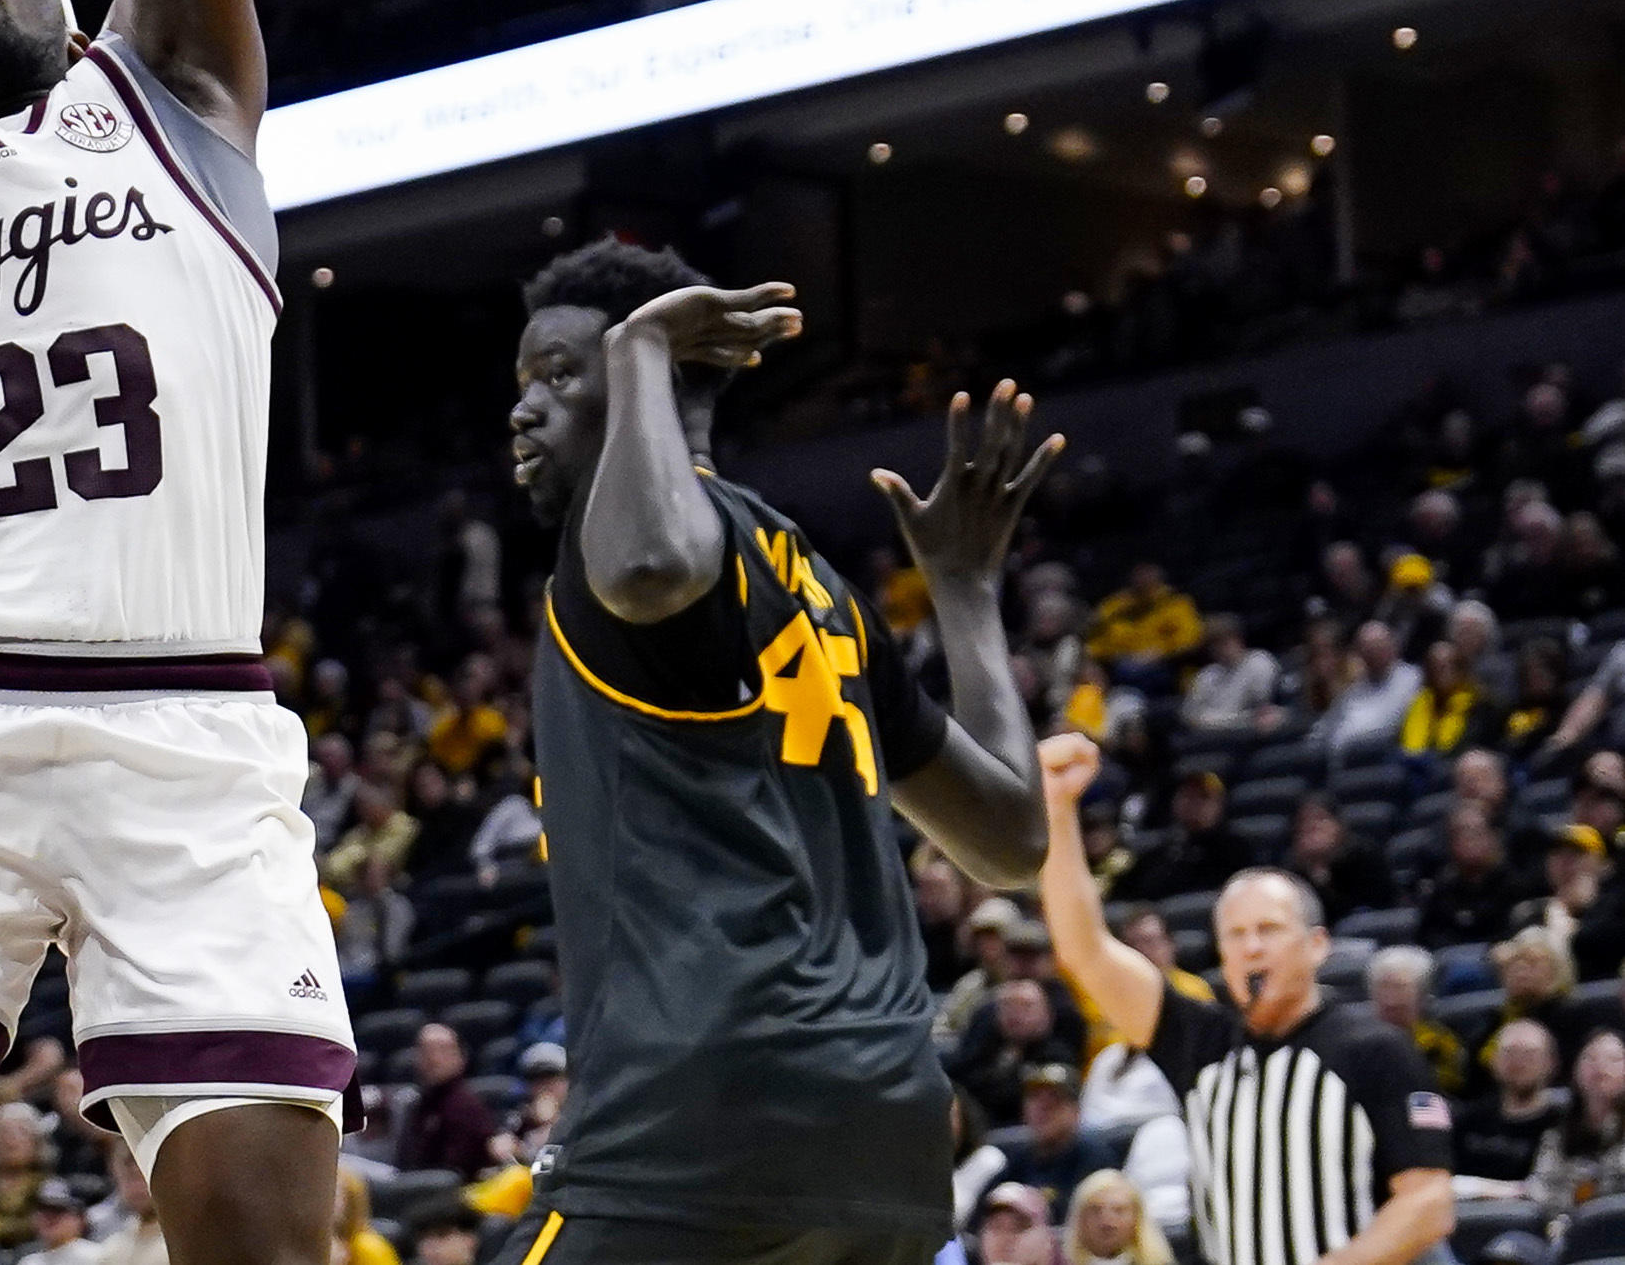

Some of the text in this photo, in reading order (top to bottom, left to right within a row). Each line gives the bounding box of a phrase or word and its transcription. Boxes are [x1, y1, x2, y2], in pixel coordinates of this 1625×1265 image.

[61, 103, 116, 138] SEC
[68, 132, 129, 151] GRADUATE
[288, 985, 329, 1002] adidas
